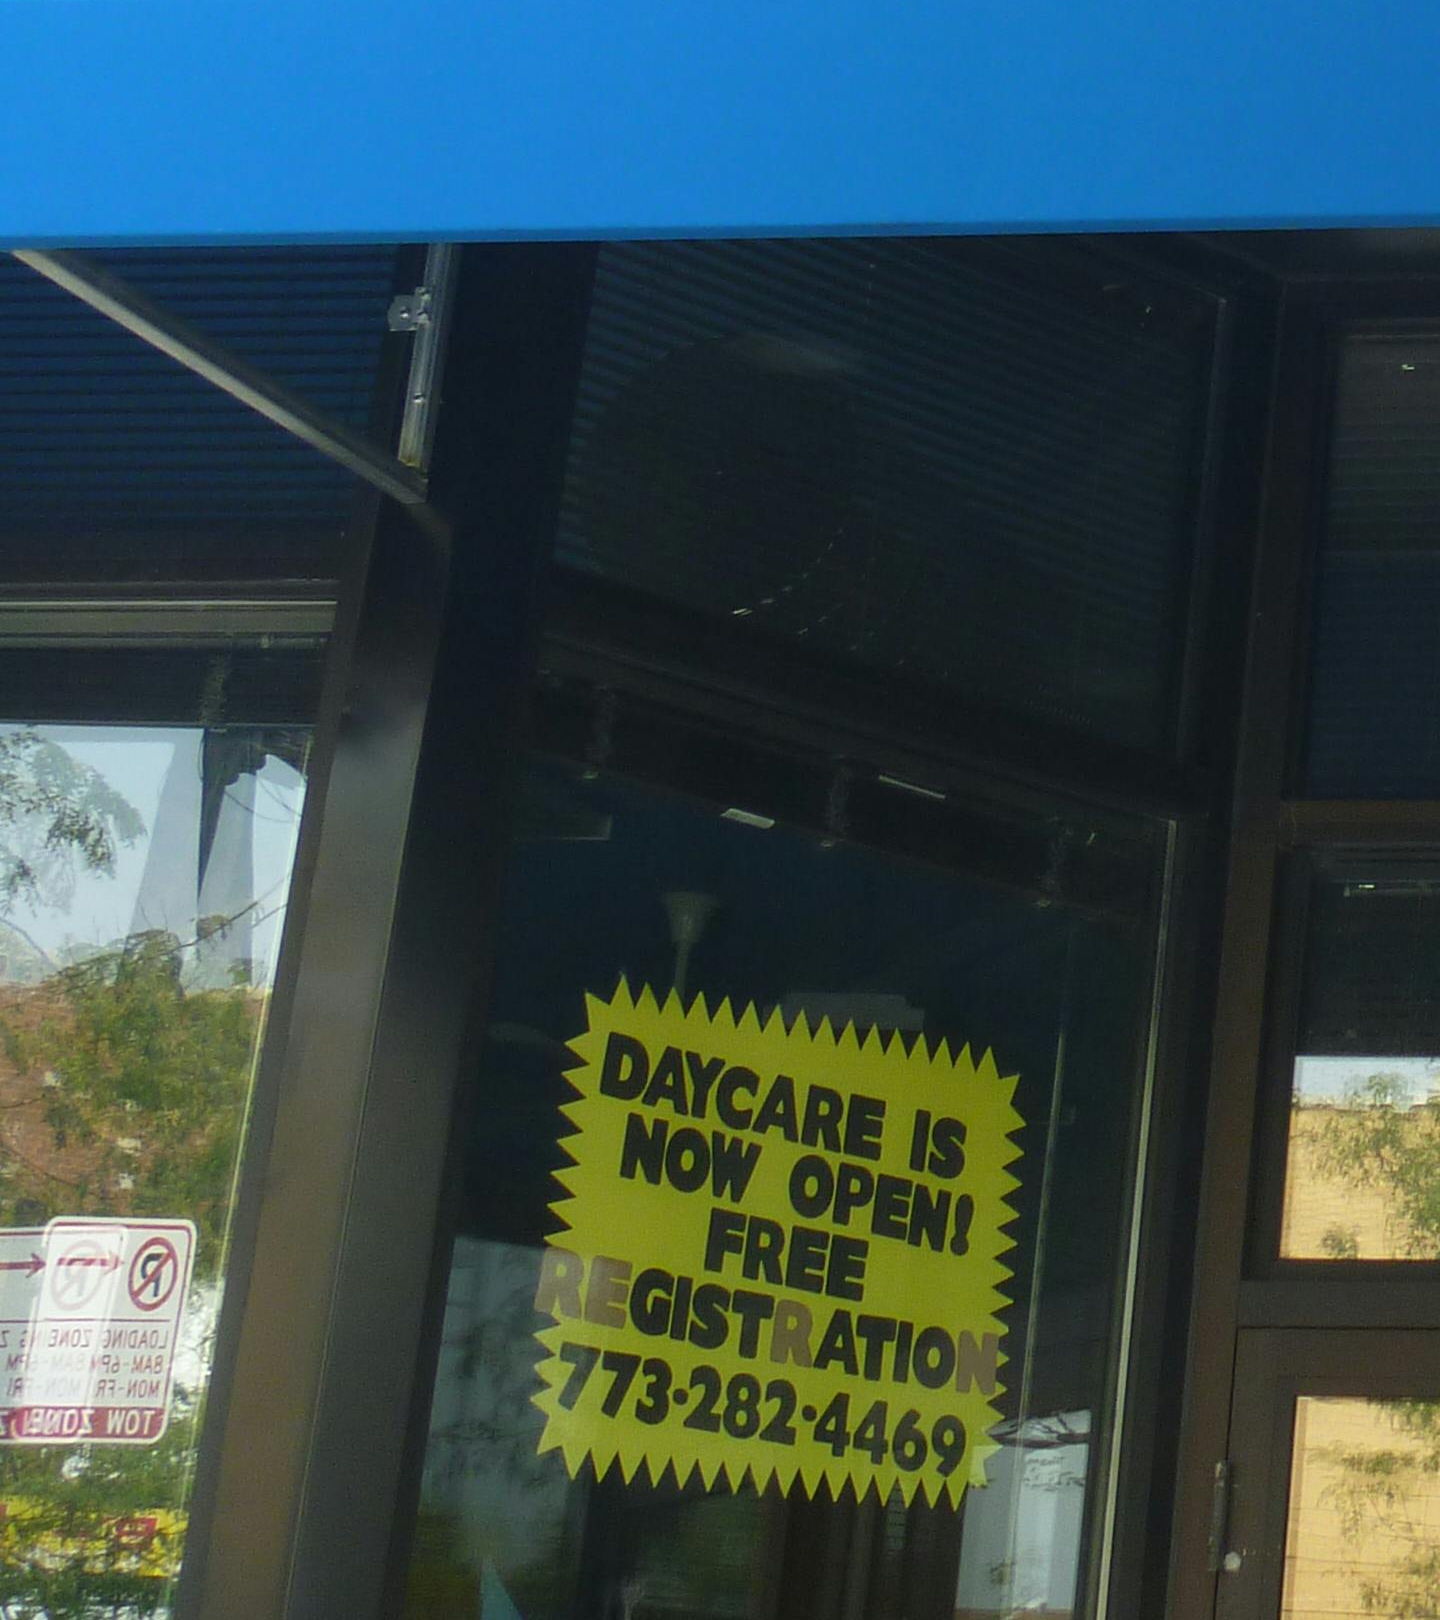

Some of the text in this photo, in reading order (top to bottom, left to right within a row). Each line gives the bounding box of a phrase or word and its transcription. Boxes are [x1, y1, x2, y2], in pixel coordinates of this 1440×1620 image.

[600, 1031, 968, 1179] DAYCARE IS
[619, 1112, 975, 1257] NOW OPEN!
[703, 1207, 869, 1302] FREE
[534, 1248, 999, 1396] REGISTRATION
